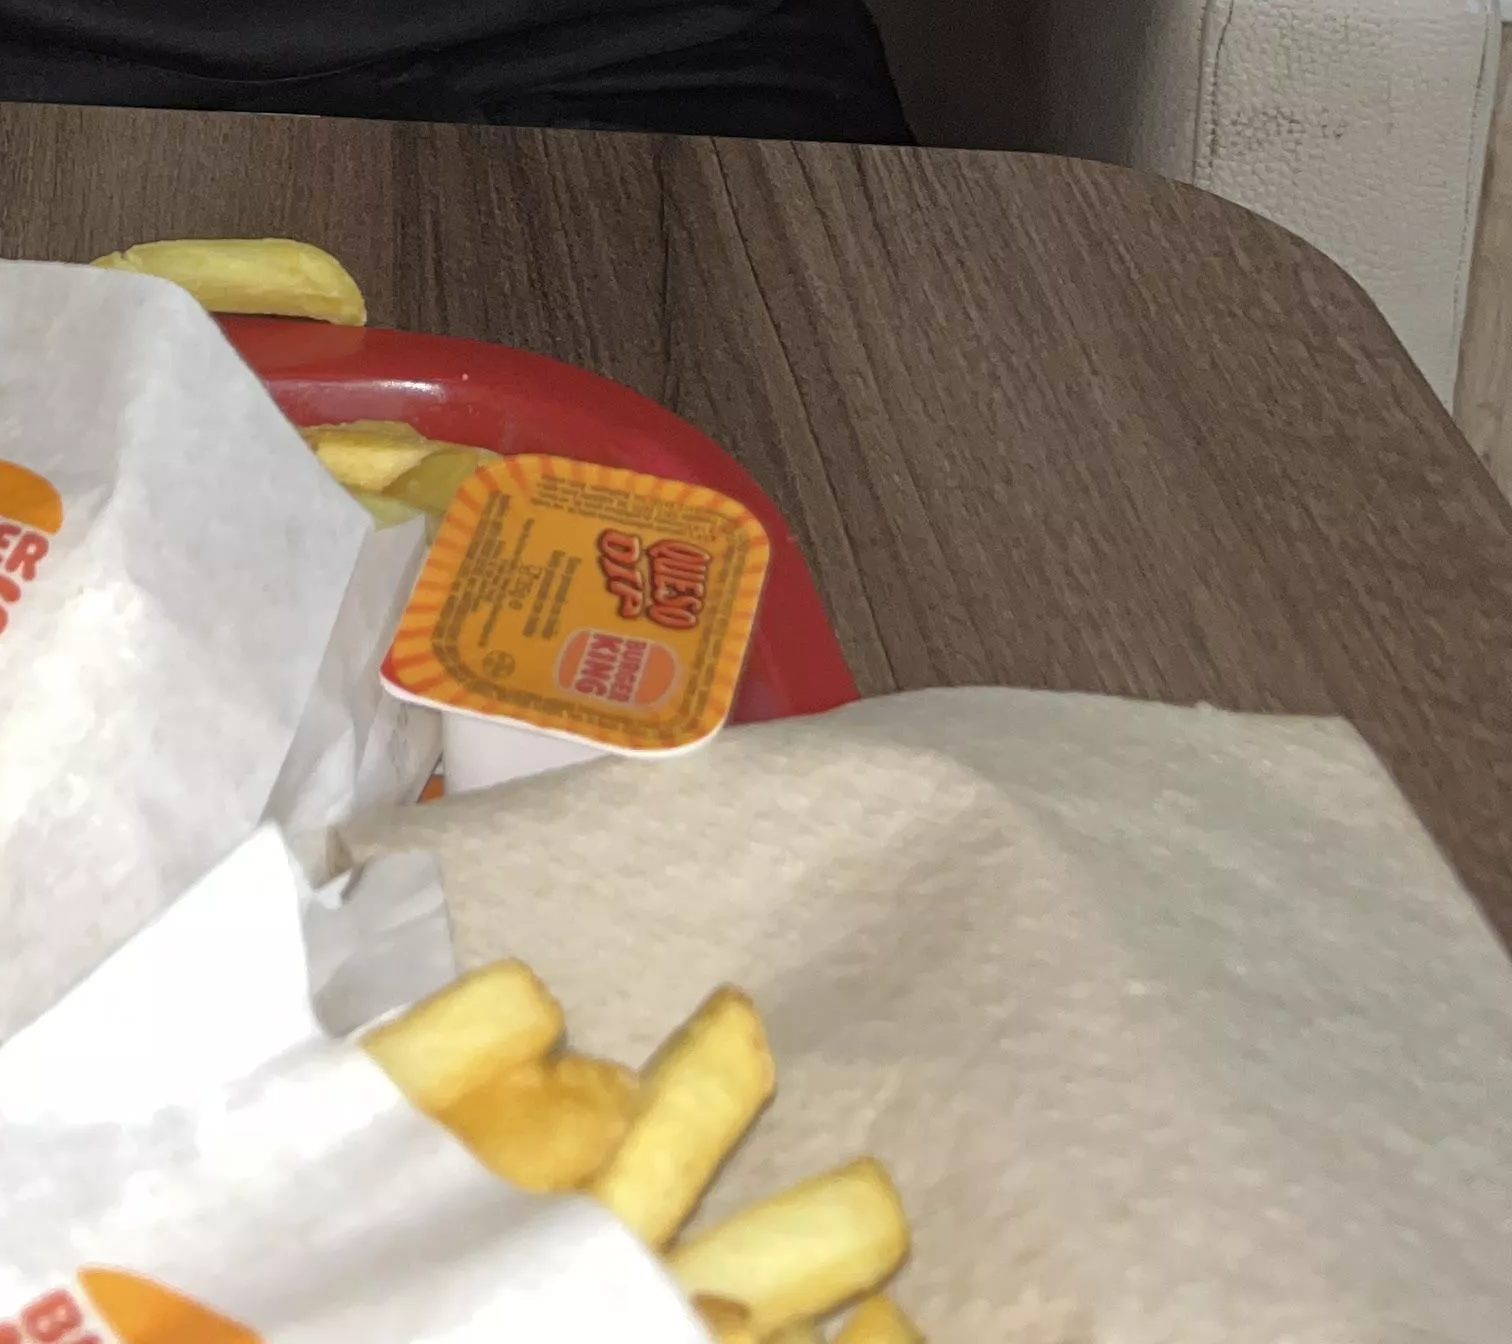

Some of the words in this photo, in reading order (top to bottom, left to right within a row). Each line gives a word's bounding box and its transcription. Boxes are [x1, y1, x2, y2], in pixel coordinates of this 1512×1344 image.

[597, 527, 644, 620] DIP
[646, 538, 711, 629] QUESO
[574, 631, 625, 696] KING
